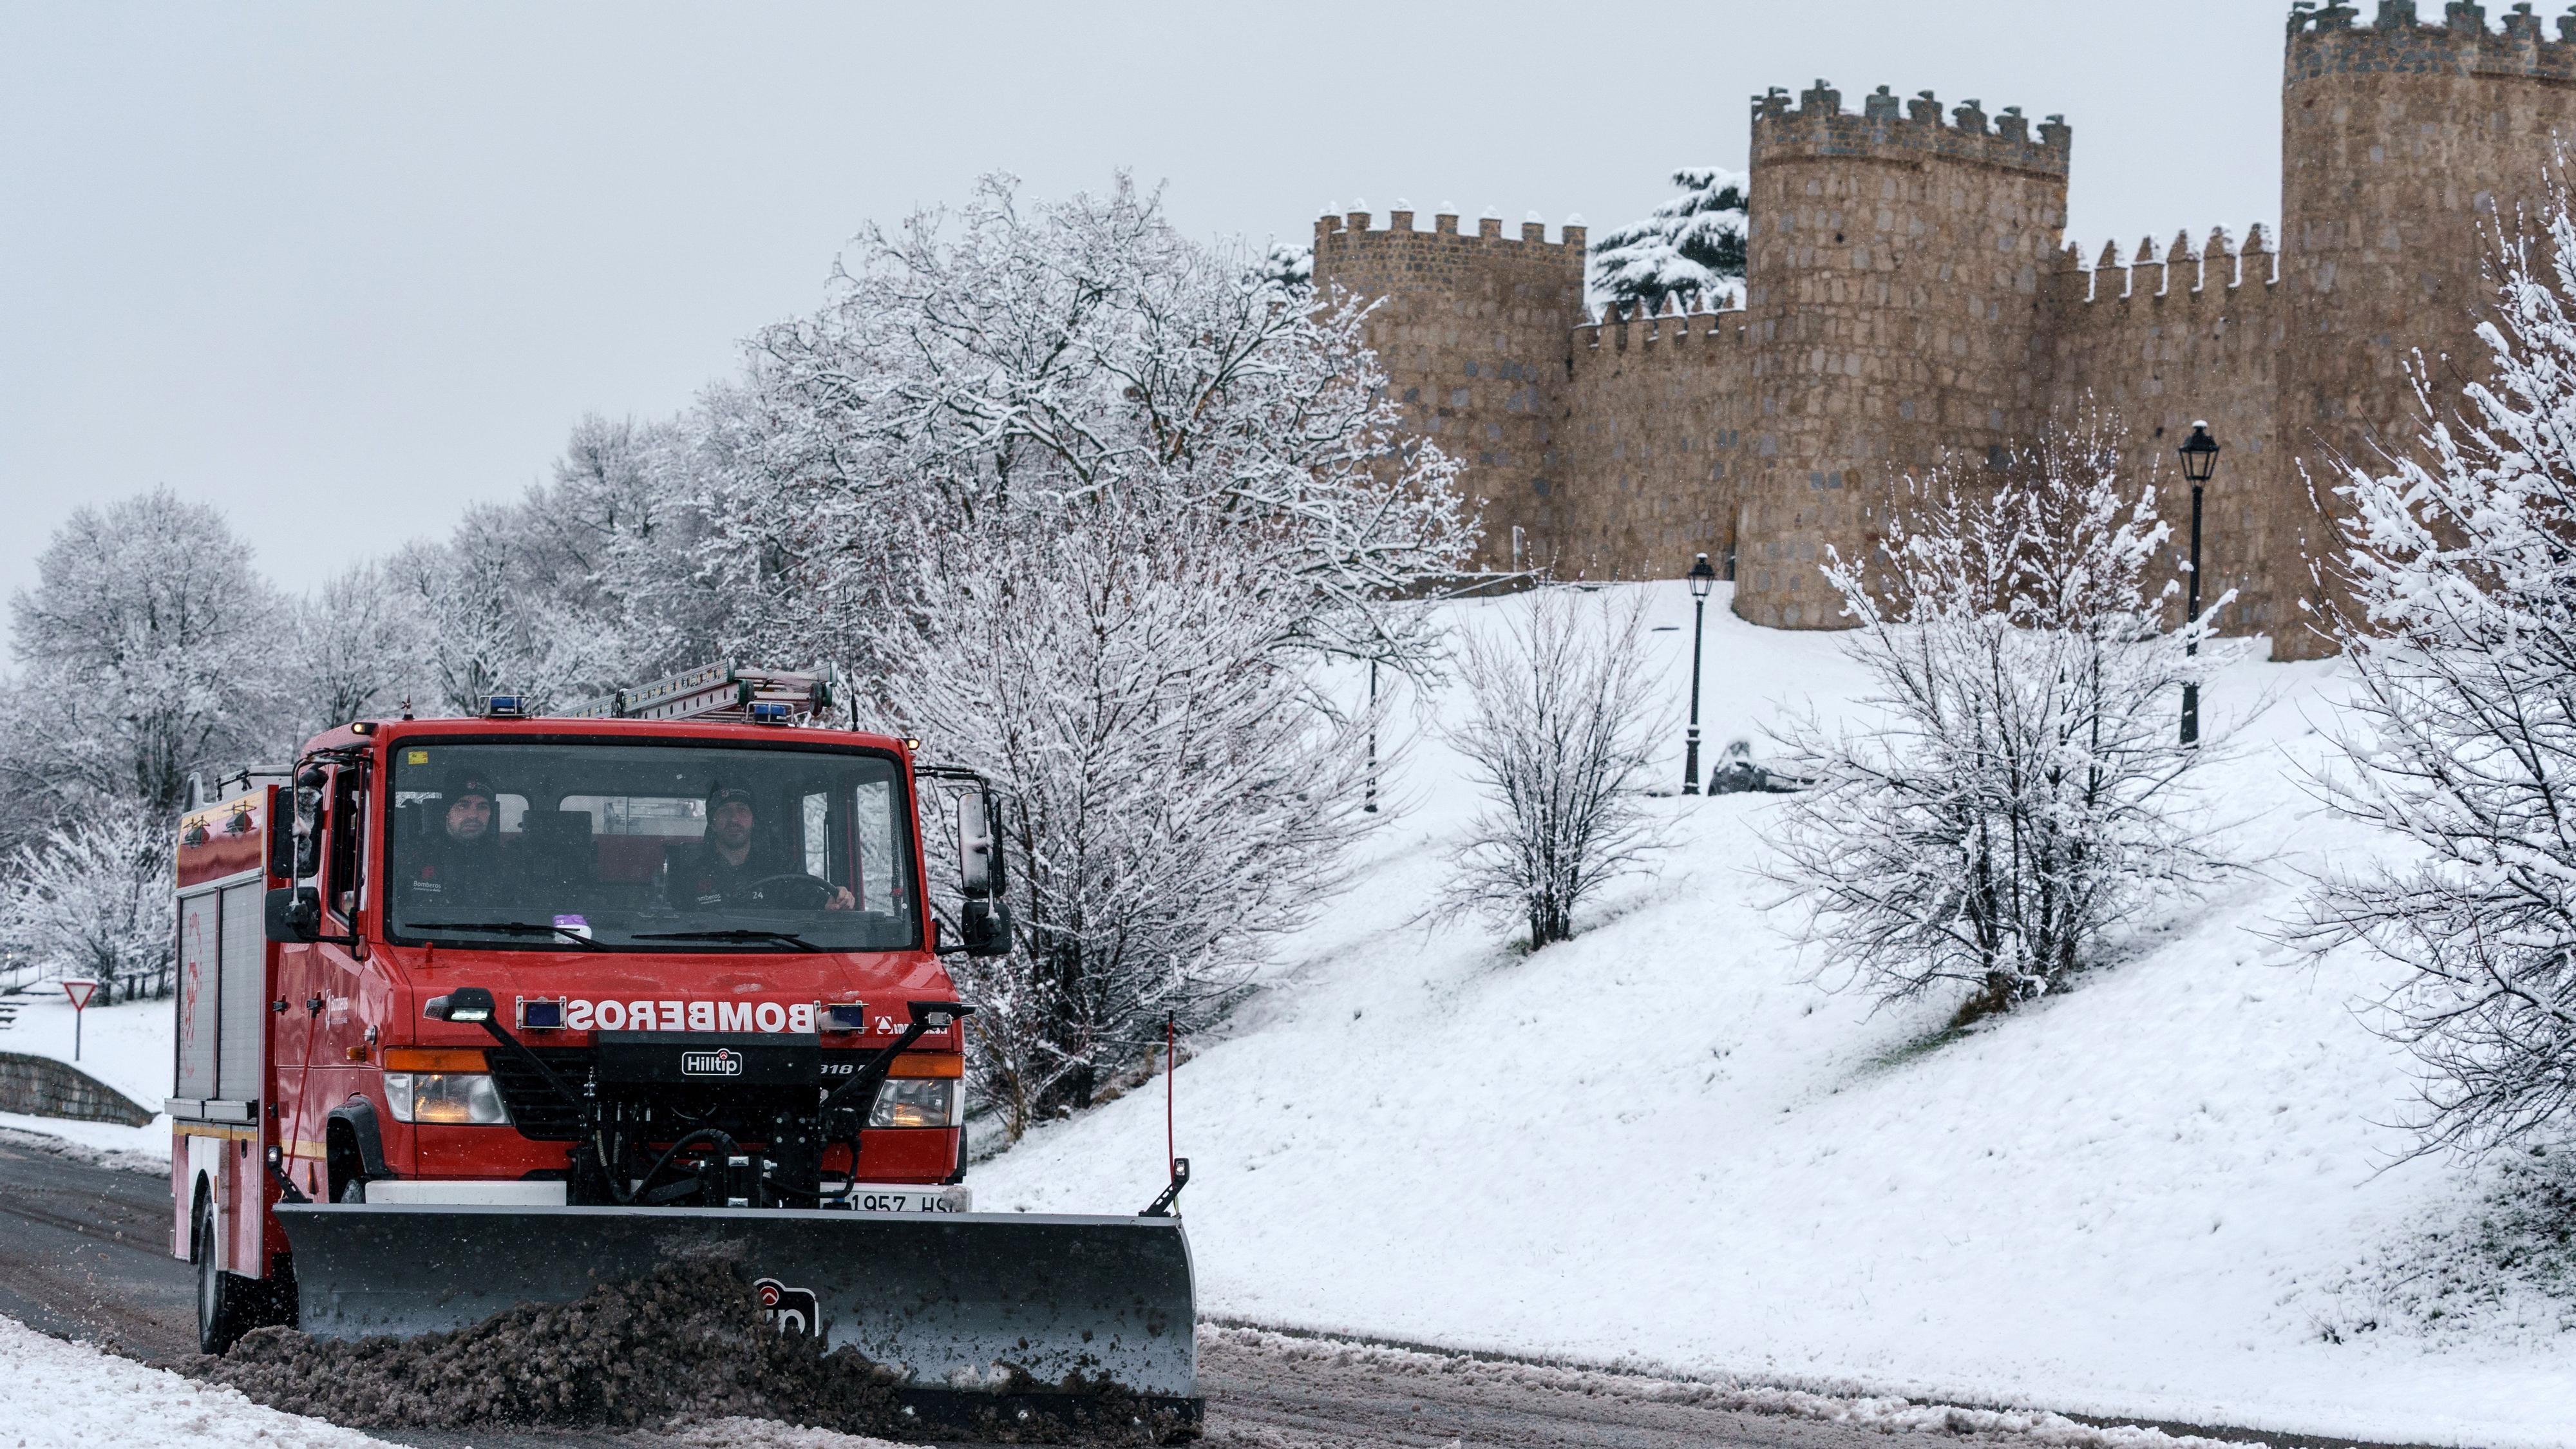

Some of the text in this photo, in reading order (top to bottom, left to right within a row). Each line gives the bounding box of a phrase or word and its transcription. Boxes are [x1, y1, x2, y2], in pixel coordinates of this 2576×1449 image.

[413, 880, 441, 889] Bomberos
[687, 1053, 737, 1075] Hilltip
[851, 1195, 958, 1213] 1957 HS
